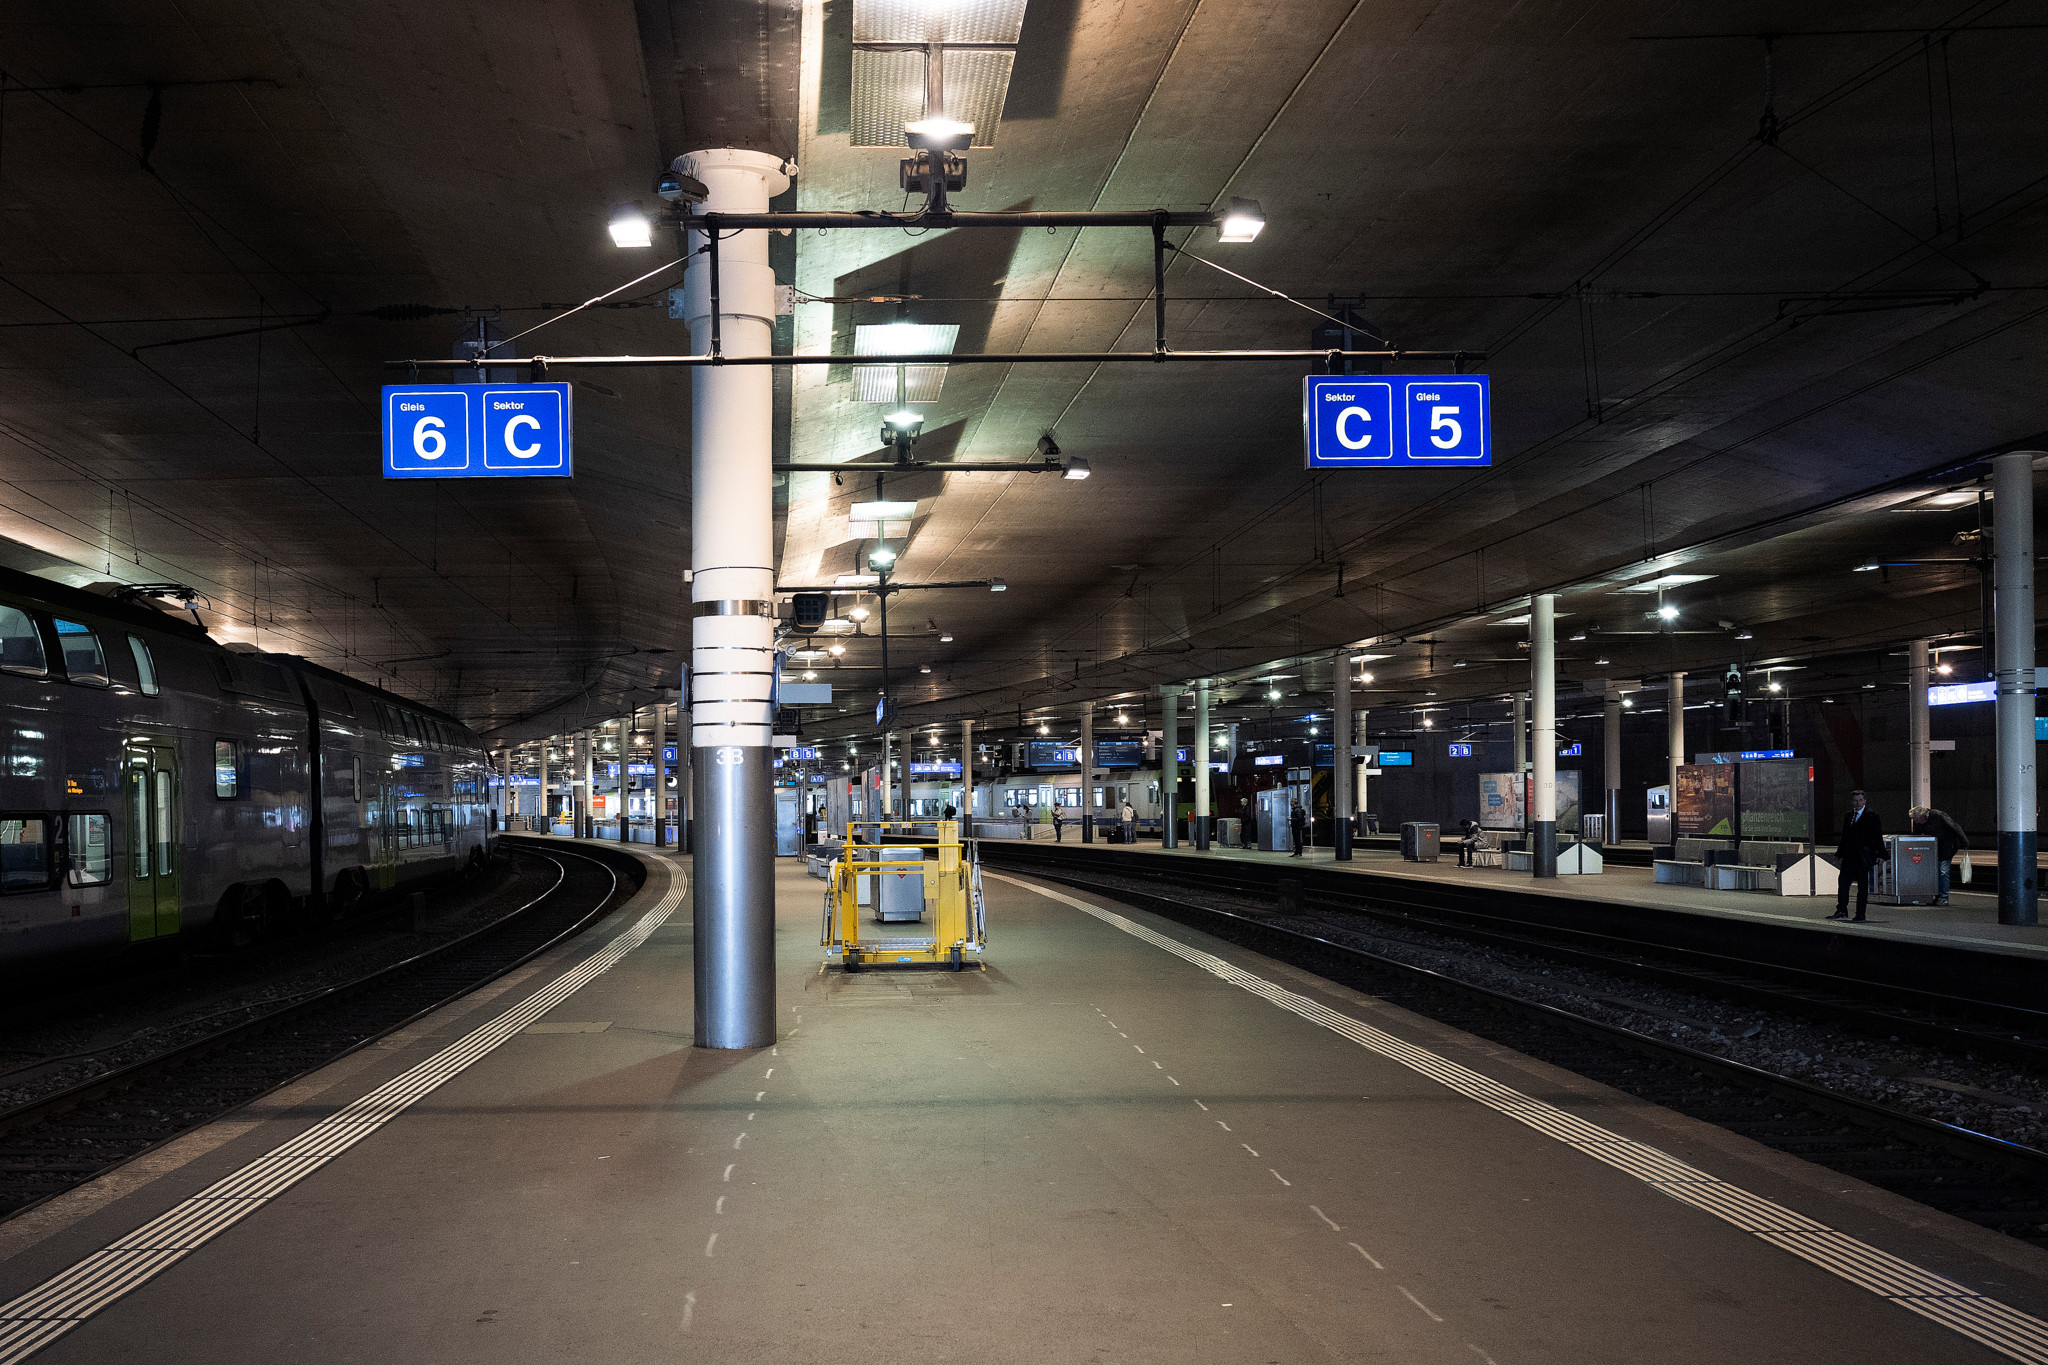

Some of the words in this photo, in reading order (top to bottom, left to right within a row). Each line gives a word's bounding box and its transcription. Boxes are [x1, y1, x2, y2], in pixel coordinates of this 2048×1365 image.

[1325, 393, 1356, 402] Sektor
[1416, 392, 1441, 401] Gleis
[400, 402, 425, 412] Gleis
[493, 401, 524, 411] Sektor
[1335, 406, 1372, 450] C
[1430, 406, 1462, 450] 5
[413, 415, 447, 460] 6
[504, 414, 542, 459] C
[666, 751, 672, 759] 6
[792, 750, 799, 758] B
[1451, 747, 1457, 755] 2
[1463, 747, 1469, 755] B
[716, 748, 744, 765] 3B
[54, 815, 64, 845] 2
